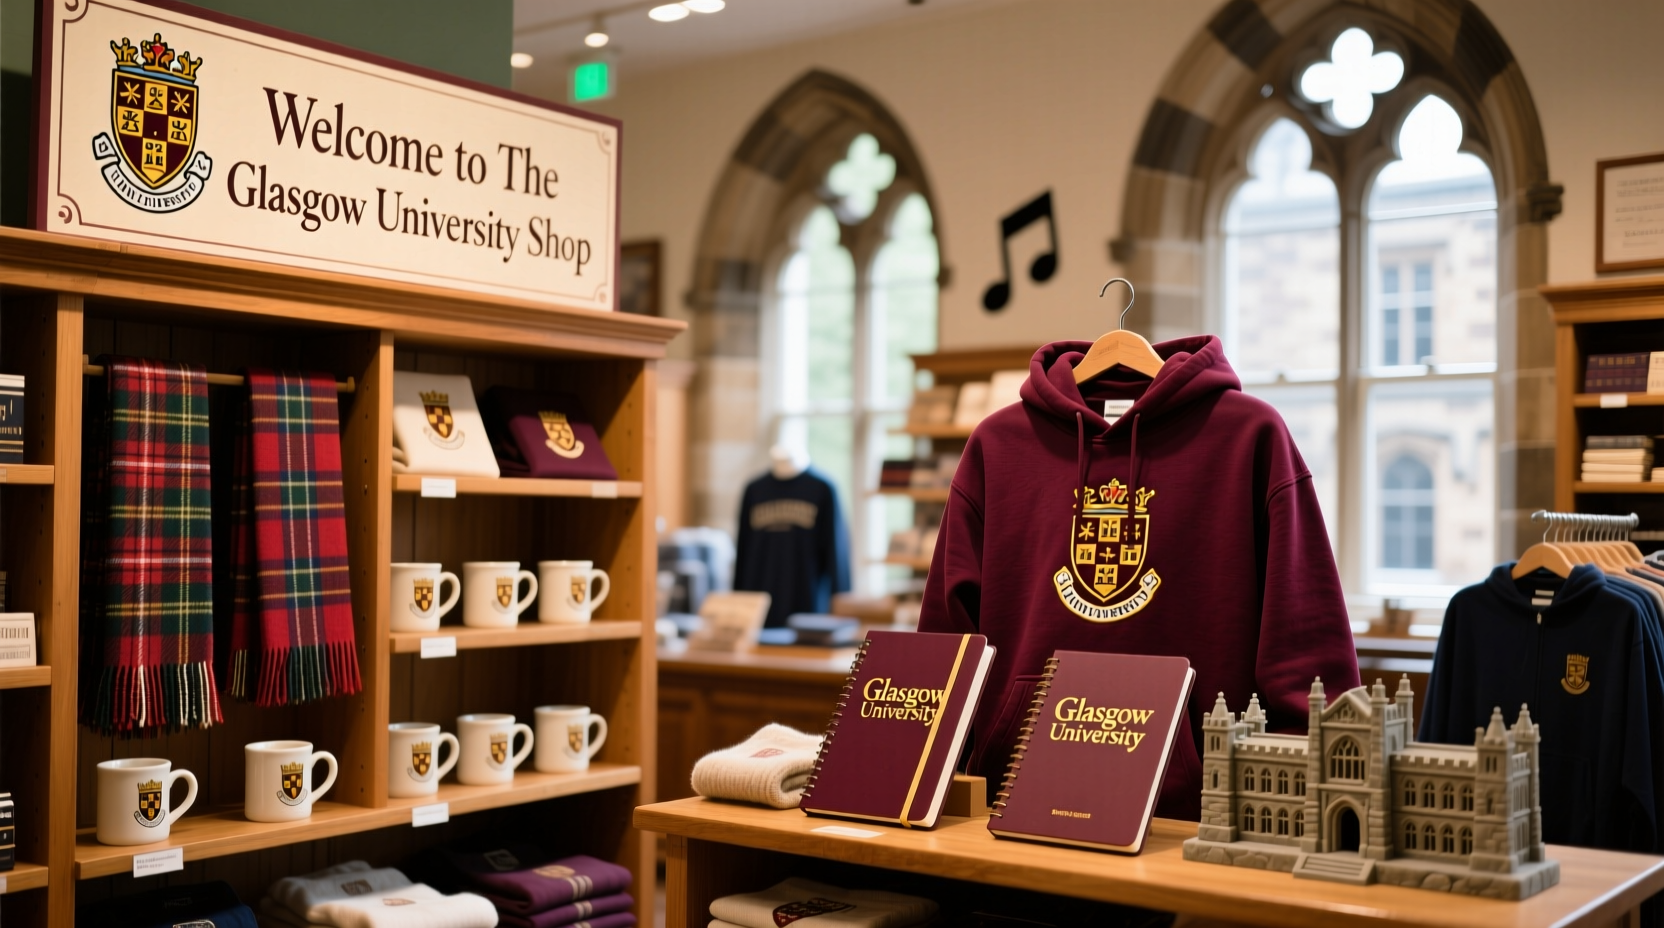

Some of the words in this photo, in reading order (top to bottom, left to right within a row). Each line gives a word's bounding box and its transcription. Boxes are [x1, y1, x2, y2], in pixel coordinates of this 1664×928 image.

[262, 86, 443, 177] Welcome
[454, 141, 487, 185] to
[497, 143, 559, 199] The
[226, 160, 367, 232] Glasgow
[375, 187, 521, 263] University
[527, 215, 591, 276] Shop
[863, 677, 944, 708] Glasgow
[860, 701, 937, 727] University
[1054, 696, 1155, 731] Glasgow
[1049, 722, 1146, 753] University
